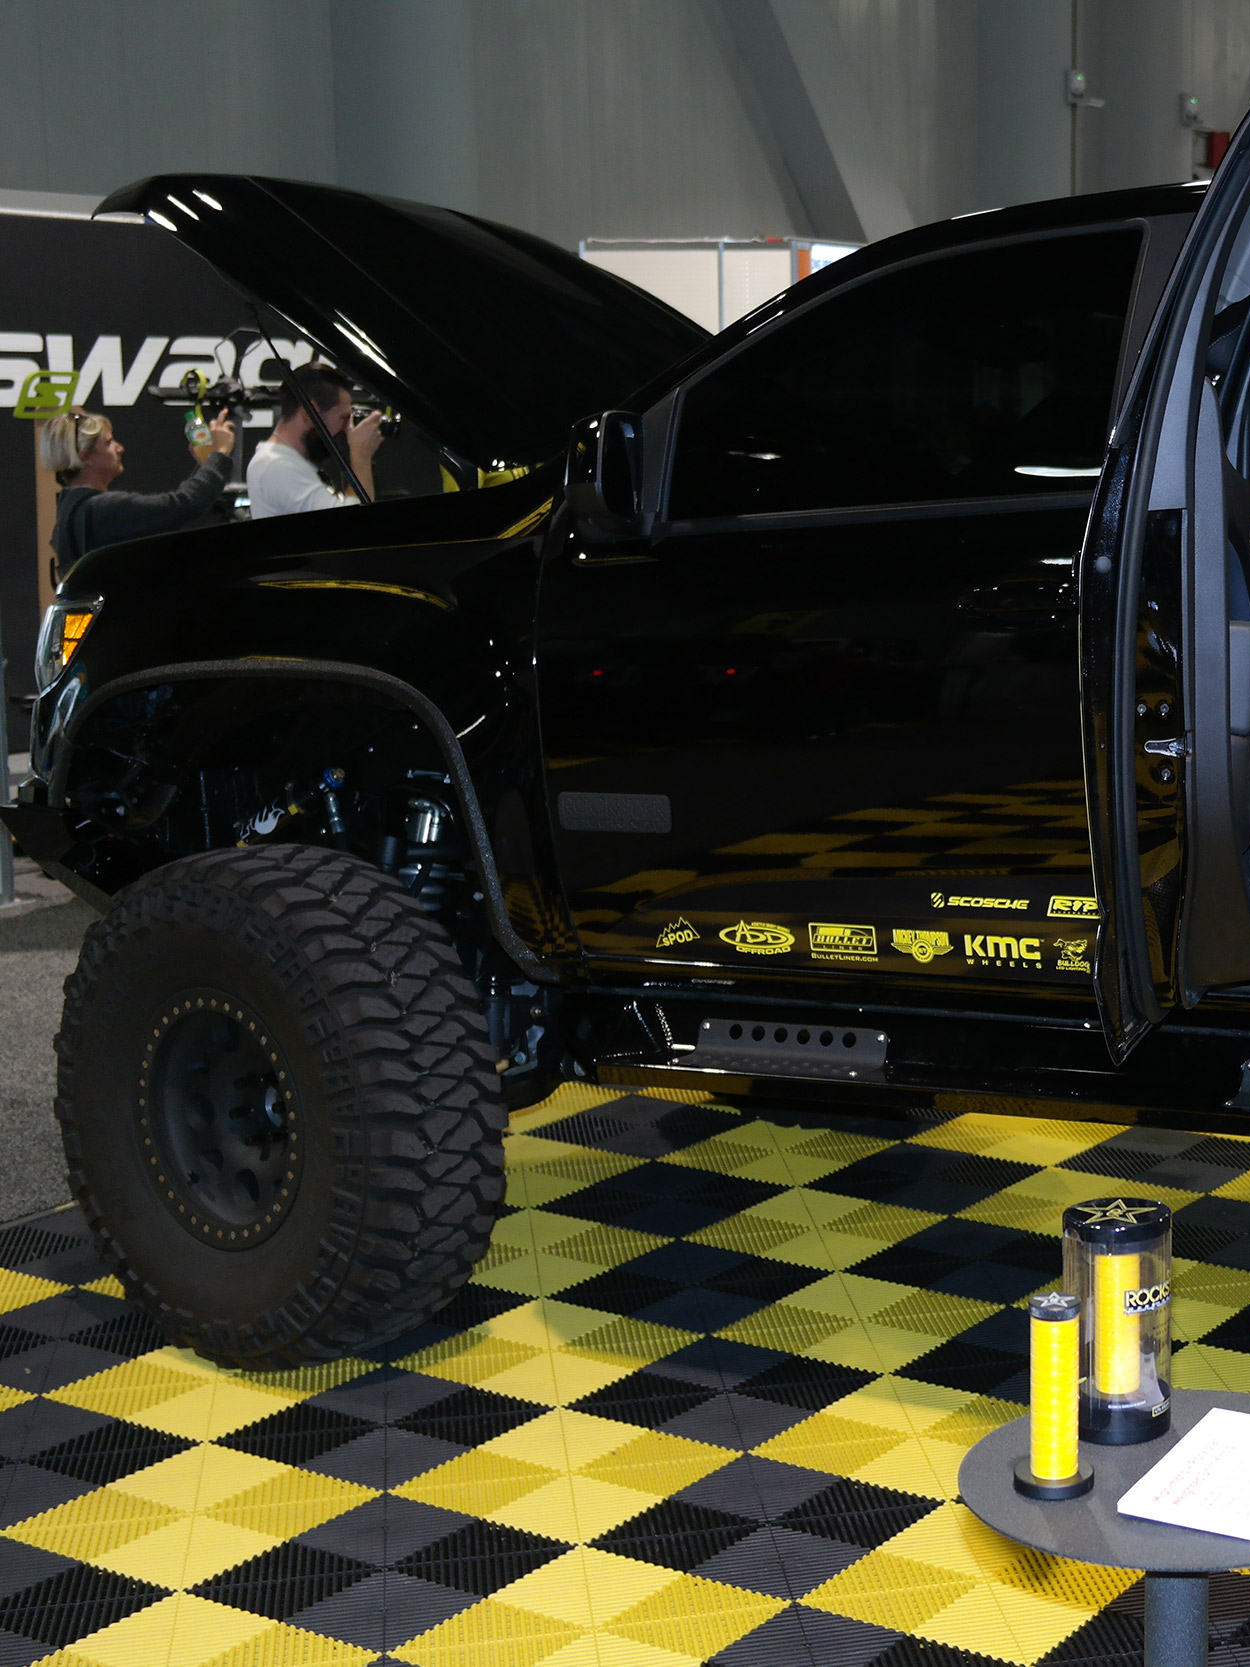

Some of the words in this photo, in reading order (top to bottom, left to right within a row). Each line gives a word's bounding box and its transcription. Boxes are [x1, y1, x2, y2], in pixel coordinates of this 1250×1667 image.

[948, 896, 1029, 909] SCOSCHE
[735, 945, 791, 956] OFFROAD
[966, 958, 1042, 969] WHEELS
[1057, 959, 1090, 969] BULLDOG
